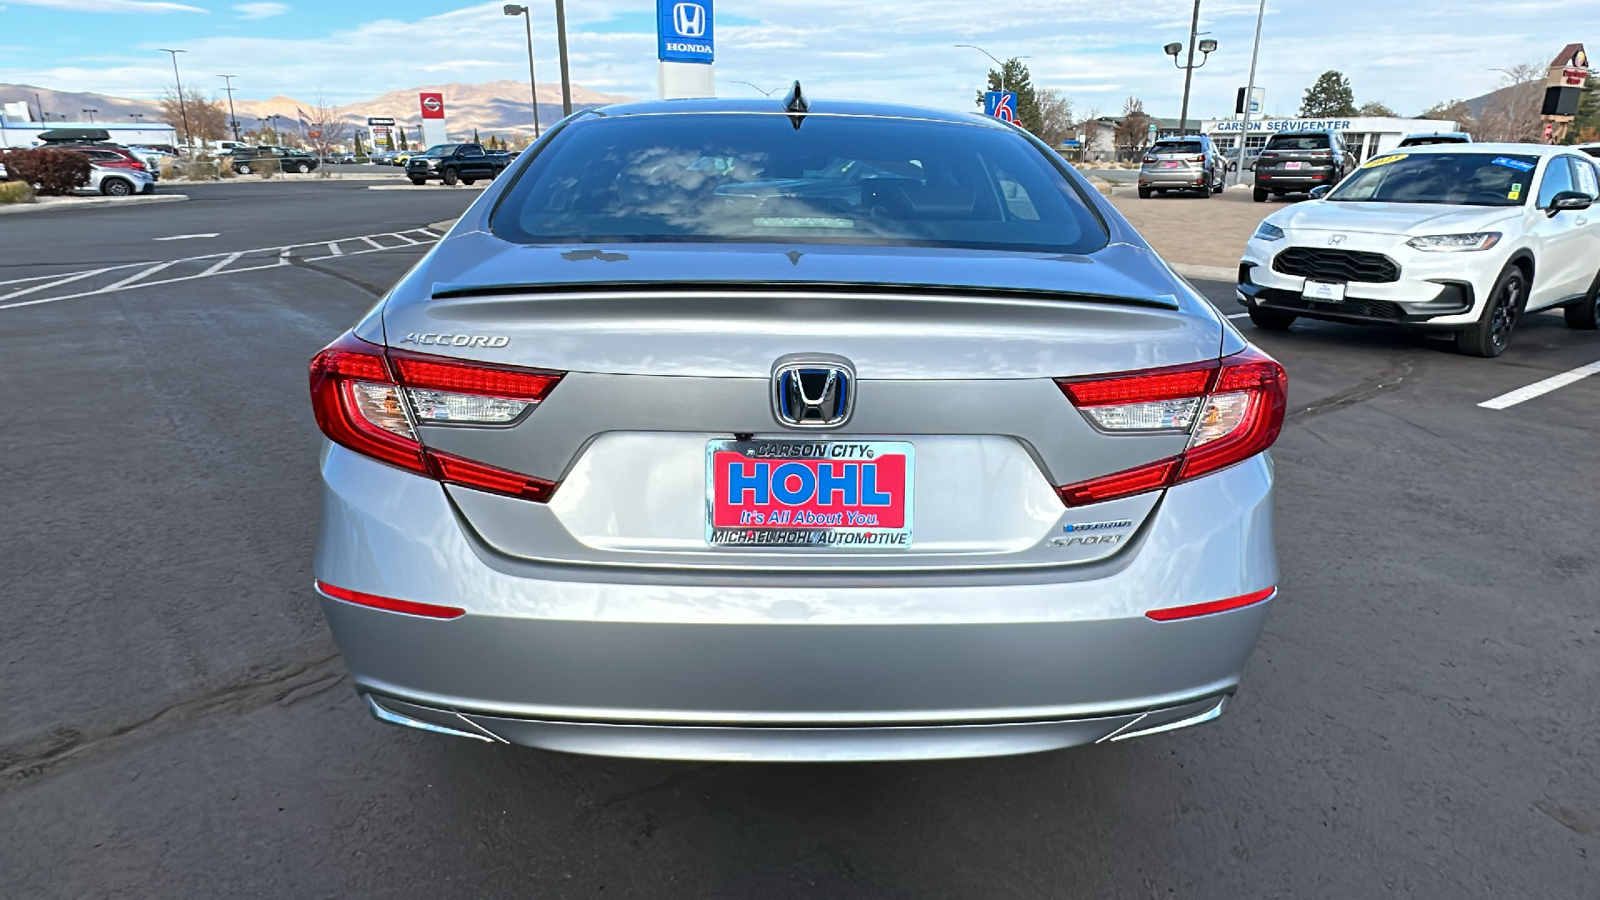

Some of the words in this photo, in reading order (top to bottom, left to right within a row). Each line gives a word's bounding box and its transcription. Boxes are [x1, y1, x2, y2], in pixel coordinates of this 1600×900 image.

[666, 42, 713, 53] HONDA
[1217, 122, 1261, 131] CARSON
[1266, 120, 1350, 131] SERVICENTER
[401, 332, 510, 348] ACCORD
[757, 443, 827, 458] CARSON
[831, 444, 868, 458] CITY
[728, 462, 892, 506] HOHL
[740, 511, 764, 524] It's
[768, 511, 790, 524] All
[792, 511, 843, 525] About
[845, 511, 879, 526] You.
[710, 531, 775, 544] MICHAEL
[776, 531, 815, 544] HOHL
[817, 532, 907, 545] AUTOMOTIVE
